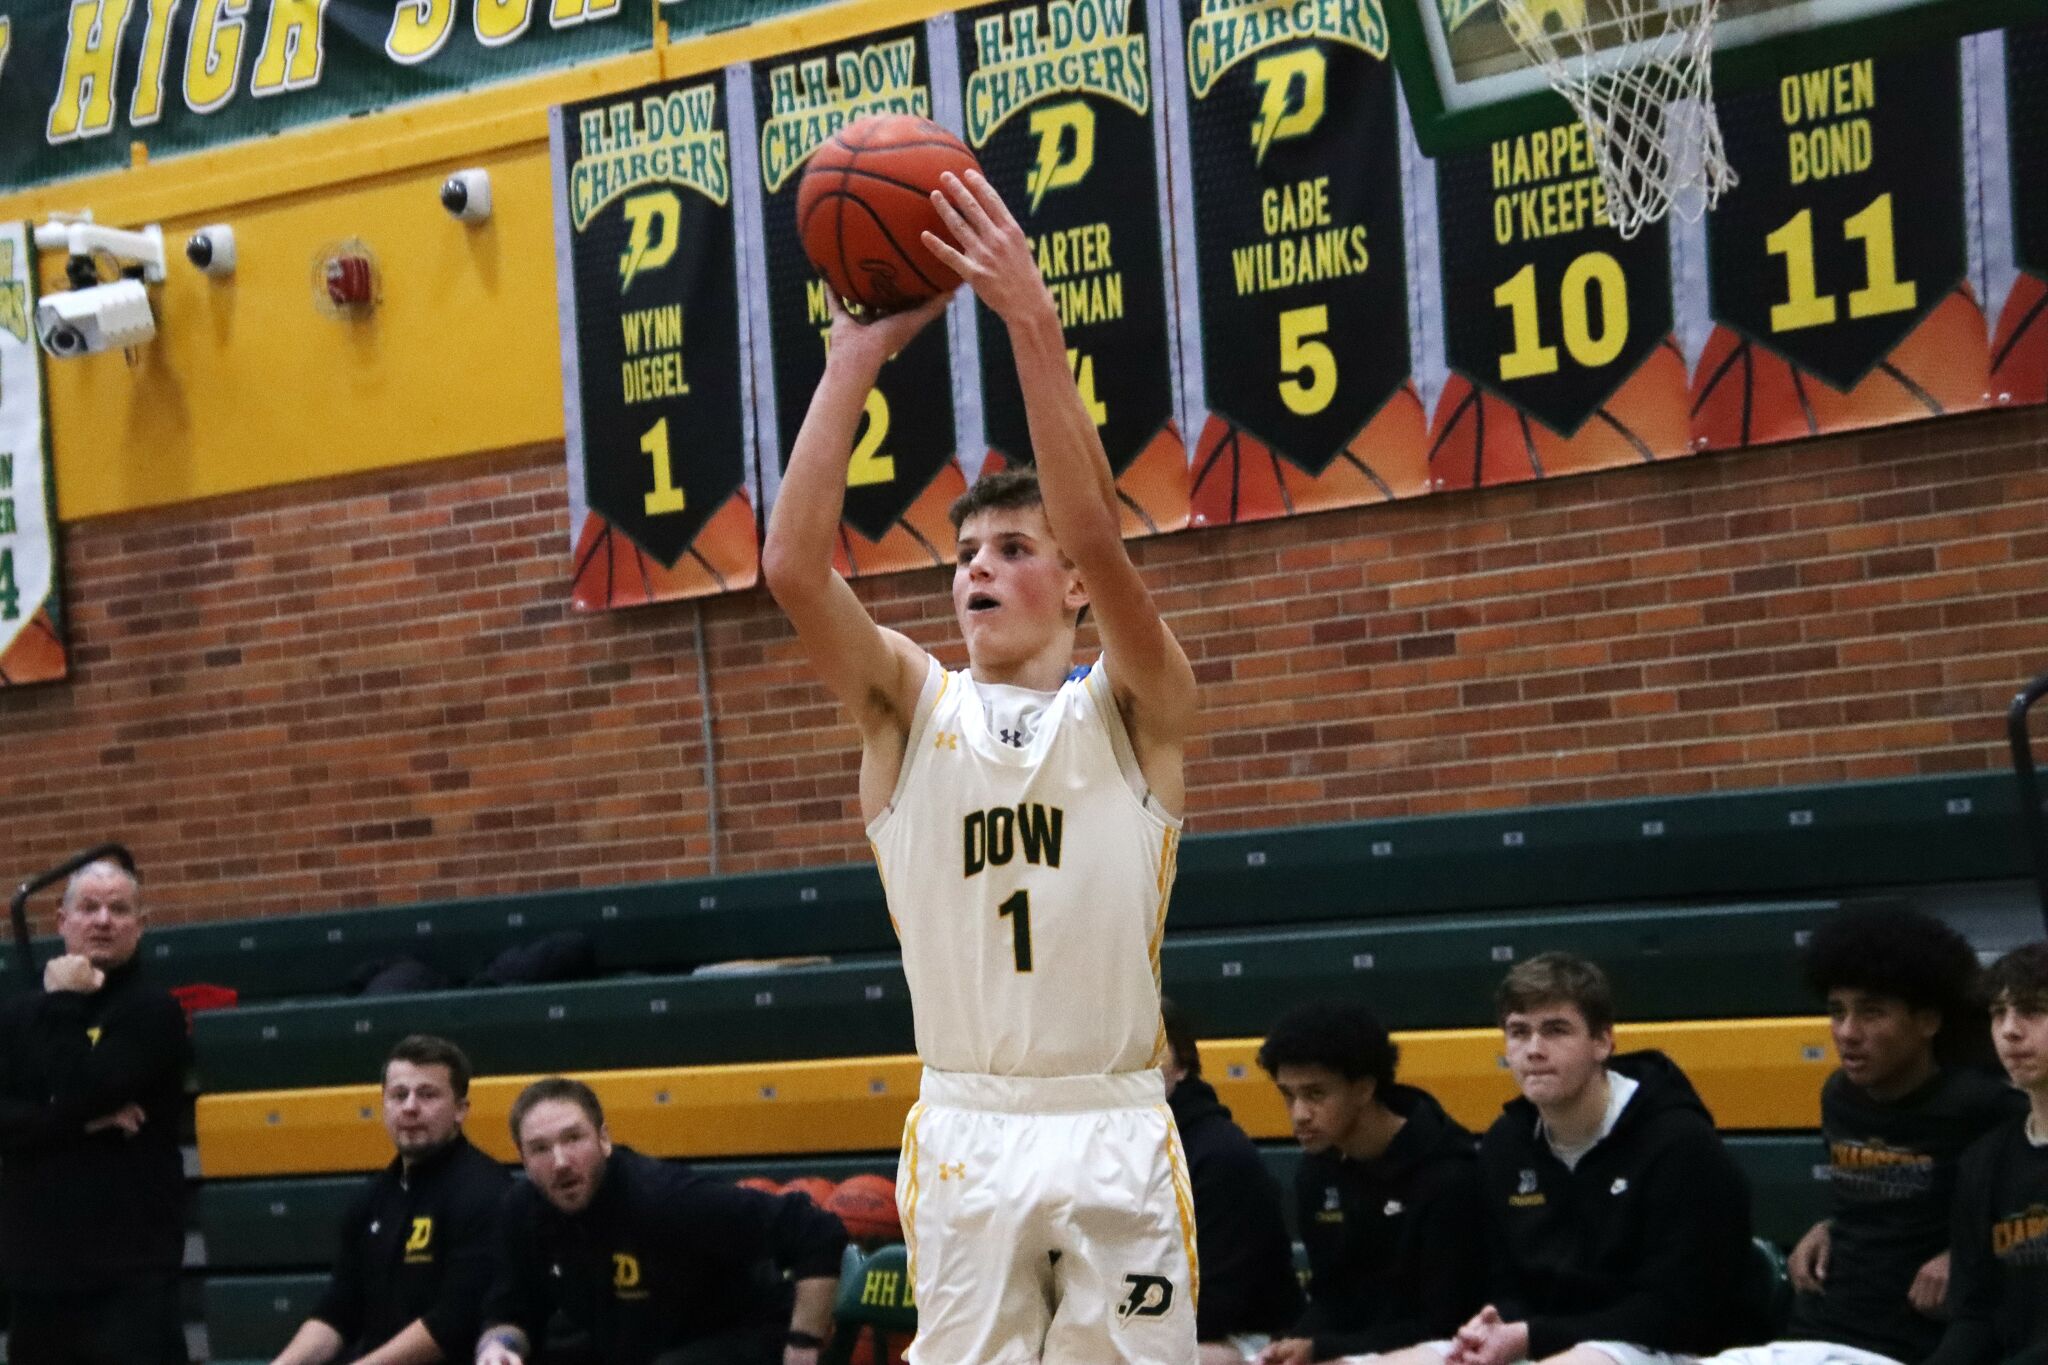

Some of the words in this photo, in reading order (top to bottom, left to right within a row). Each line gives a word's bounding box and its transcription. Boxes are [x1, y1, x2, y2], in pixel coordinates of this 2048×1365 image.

[967, 34, 1148, 148] CHARGERS
[1780, 58, 1876, 127] OWEN
[571, 131, 728, 231] CHARGERS
[762, 87, 928, 192] CHAR
[1789, 118, 1874, 186] BOND
[1262, 177, 1332, 236] GABE
[1025, 223, 1113, 281] ARTER
[1231, 224, 1370, 296] WILBANKS
[1765, 191, 1917, 334] 11
[621, 303, 684, 356] WYNN
[1494, 251, 1630, 380] 10
[621, 351, 690, 405] DIEGEL
[1278, 304, 1338, 416] 5
[639, 416, 685, 516] 1
[846, 387, 895, 487] 2
[964, 802, 1064, 879] DOW
[998, 889, 1034, 974] 1
